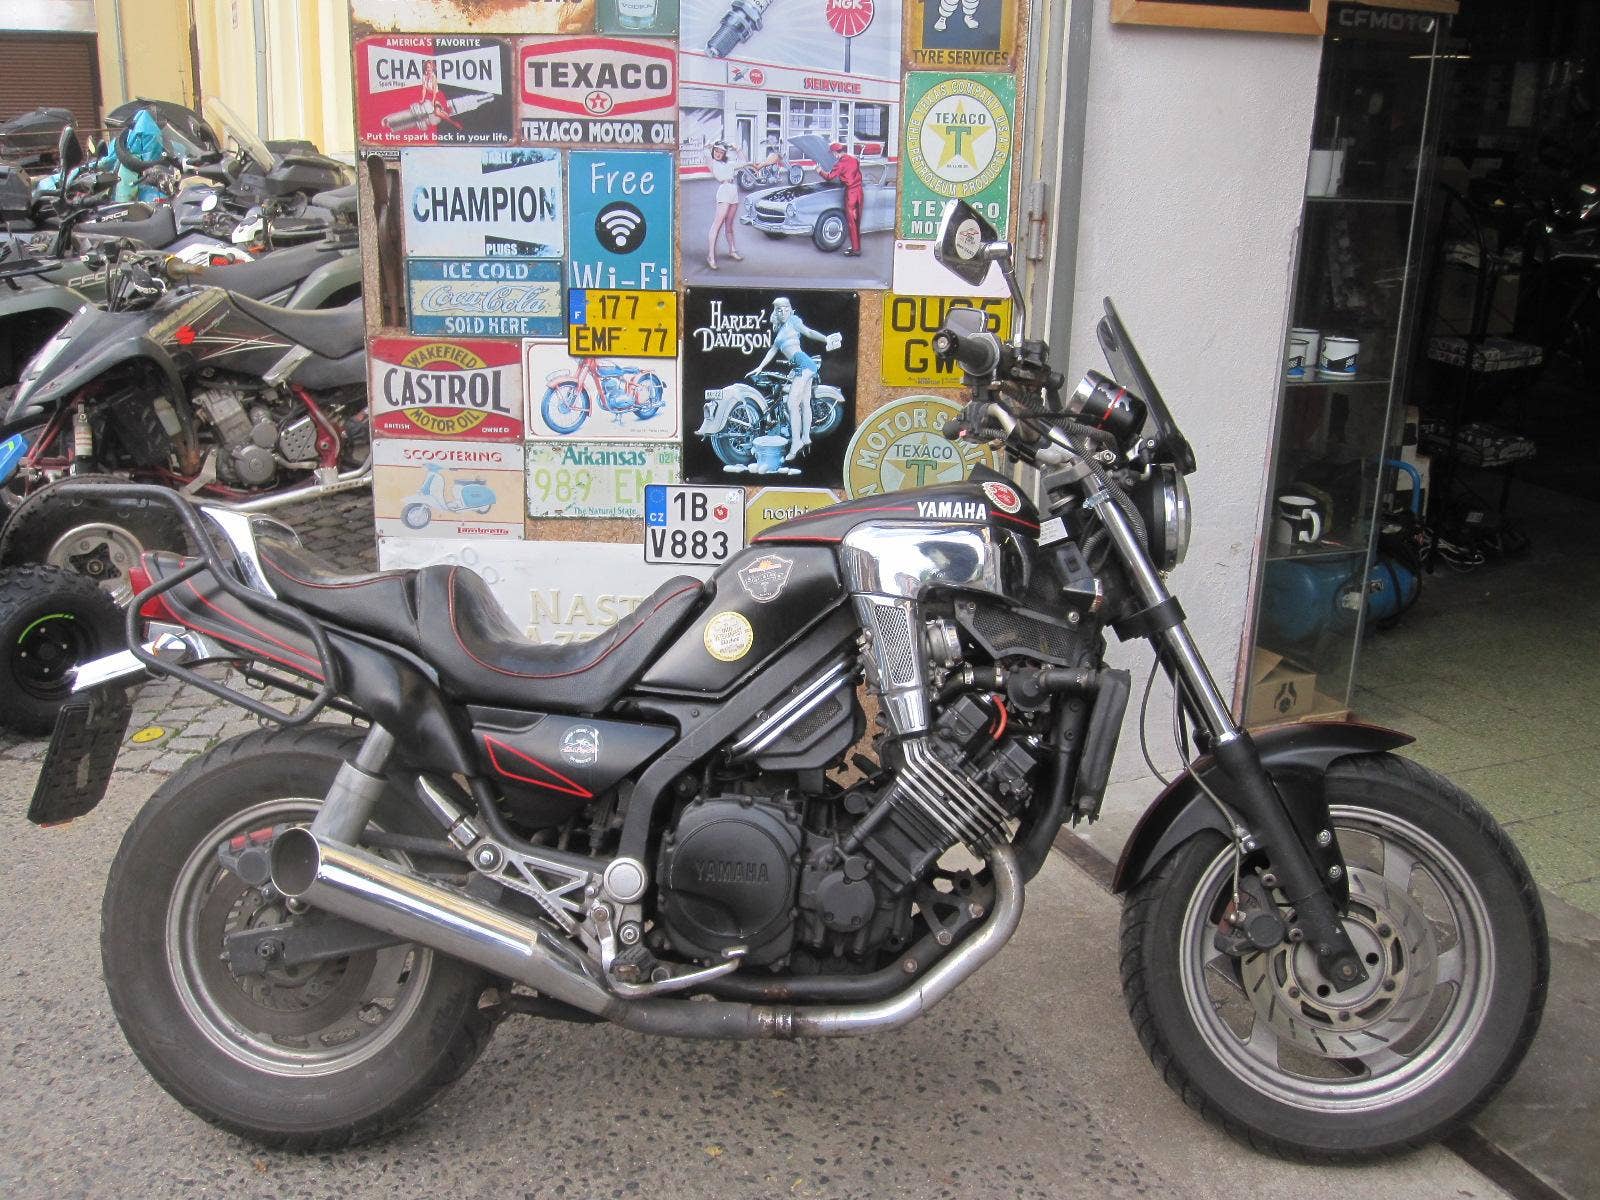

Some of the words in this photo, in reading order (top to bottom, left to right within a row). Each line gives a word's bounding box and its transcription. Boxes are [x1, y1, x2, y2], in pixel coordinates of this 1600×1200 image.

[386, 37, 432, 47] AMERICA'S
[435, 38, 481, 47] FAVORITE
[912, 50, 944, 65] TYRE
[947, 50, 1009, 66] SERVICES
[528, 61, 668, 90] TEXACO
[804, 77, 862, 95] SERVICE
[909, 119, 922, 142] THE
[916, 84, 948, 115] TEXAS
[951, 79, 1001, 115] COMPANY
[935, 112, 987, 125] TEXACO
[366, 132, 383, 142] Put
[385, 132, 401, 142] the
[403, 133, 429, 144] spark
[431, 133, 454, 142] back
[456, 133, 466, 142] in
[468, 134, 491, 144] your
[521, 121, 583, 143] TEXACO
[588, 122, 644, 144] MOTOR
[650, 123, 674, 144] OIL
[589, 161, 656, 196] Free
[910, 146, 958, 197] PETROLEUM
[962, 148, 1007, 196] PRODUCTS
[412, 185, 557, 223] CHAMPION
[911, 200, 1000, 219] TEXCO
[485, 242, 518, 256] PLUGS
[443, 263, 474, 280] ICE
[478, 263, 529, 280] COLD
[572, 260, 668, 289] Wi-Fi
[574, 311, 582, 319] F
[444, 317, 485, 334] SOLD
[488, 317, 530, 335] HERE
[574, 326, 622, 353] EMF
[638, 327, 669, 353] 77
[407, 345, 478, 369] WAKEFIELD
[383, 367, 511, 414] CASTROL
[410, 409, 456, 432] MOTOR
[457, 409, 481, 429] OIL
[856, 408, 929, 470] MOTOR
[402, 449, 503, 463] SCOOTERING
[561, 446, 647, 466] Arkansas
[893, 444, 953, 460] TEXACO
[534, 468, 593, 504] 989
[573, 507, 588, 515] The
[588, 507, 617, 515] Natural
[617, 507, 637, 515] State
[673, 492, 708, 522] 1B
[917, 501, 987, 520] YAMAHA
[650, 513, 664, 523] CZ
[457, 527, 509, 535] Lambretta
[651, 528, 729, 560] V883
[694, 860, 770, 883] YAMAHA
